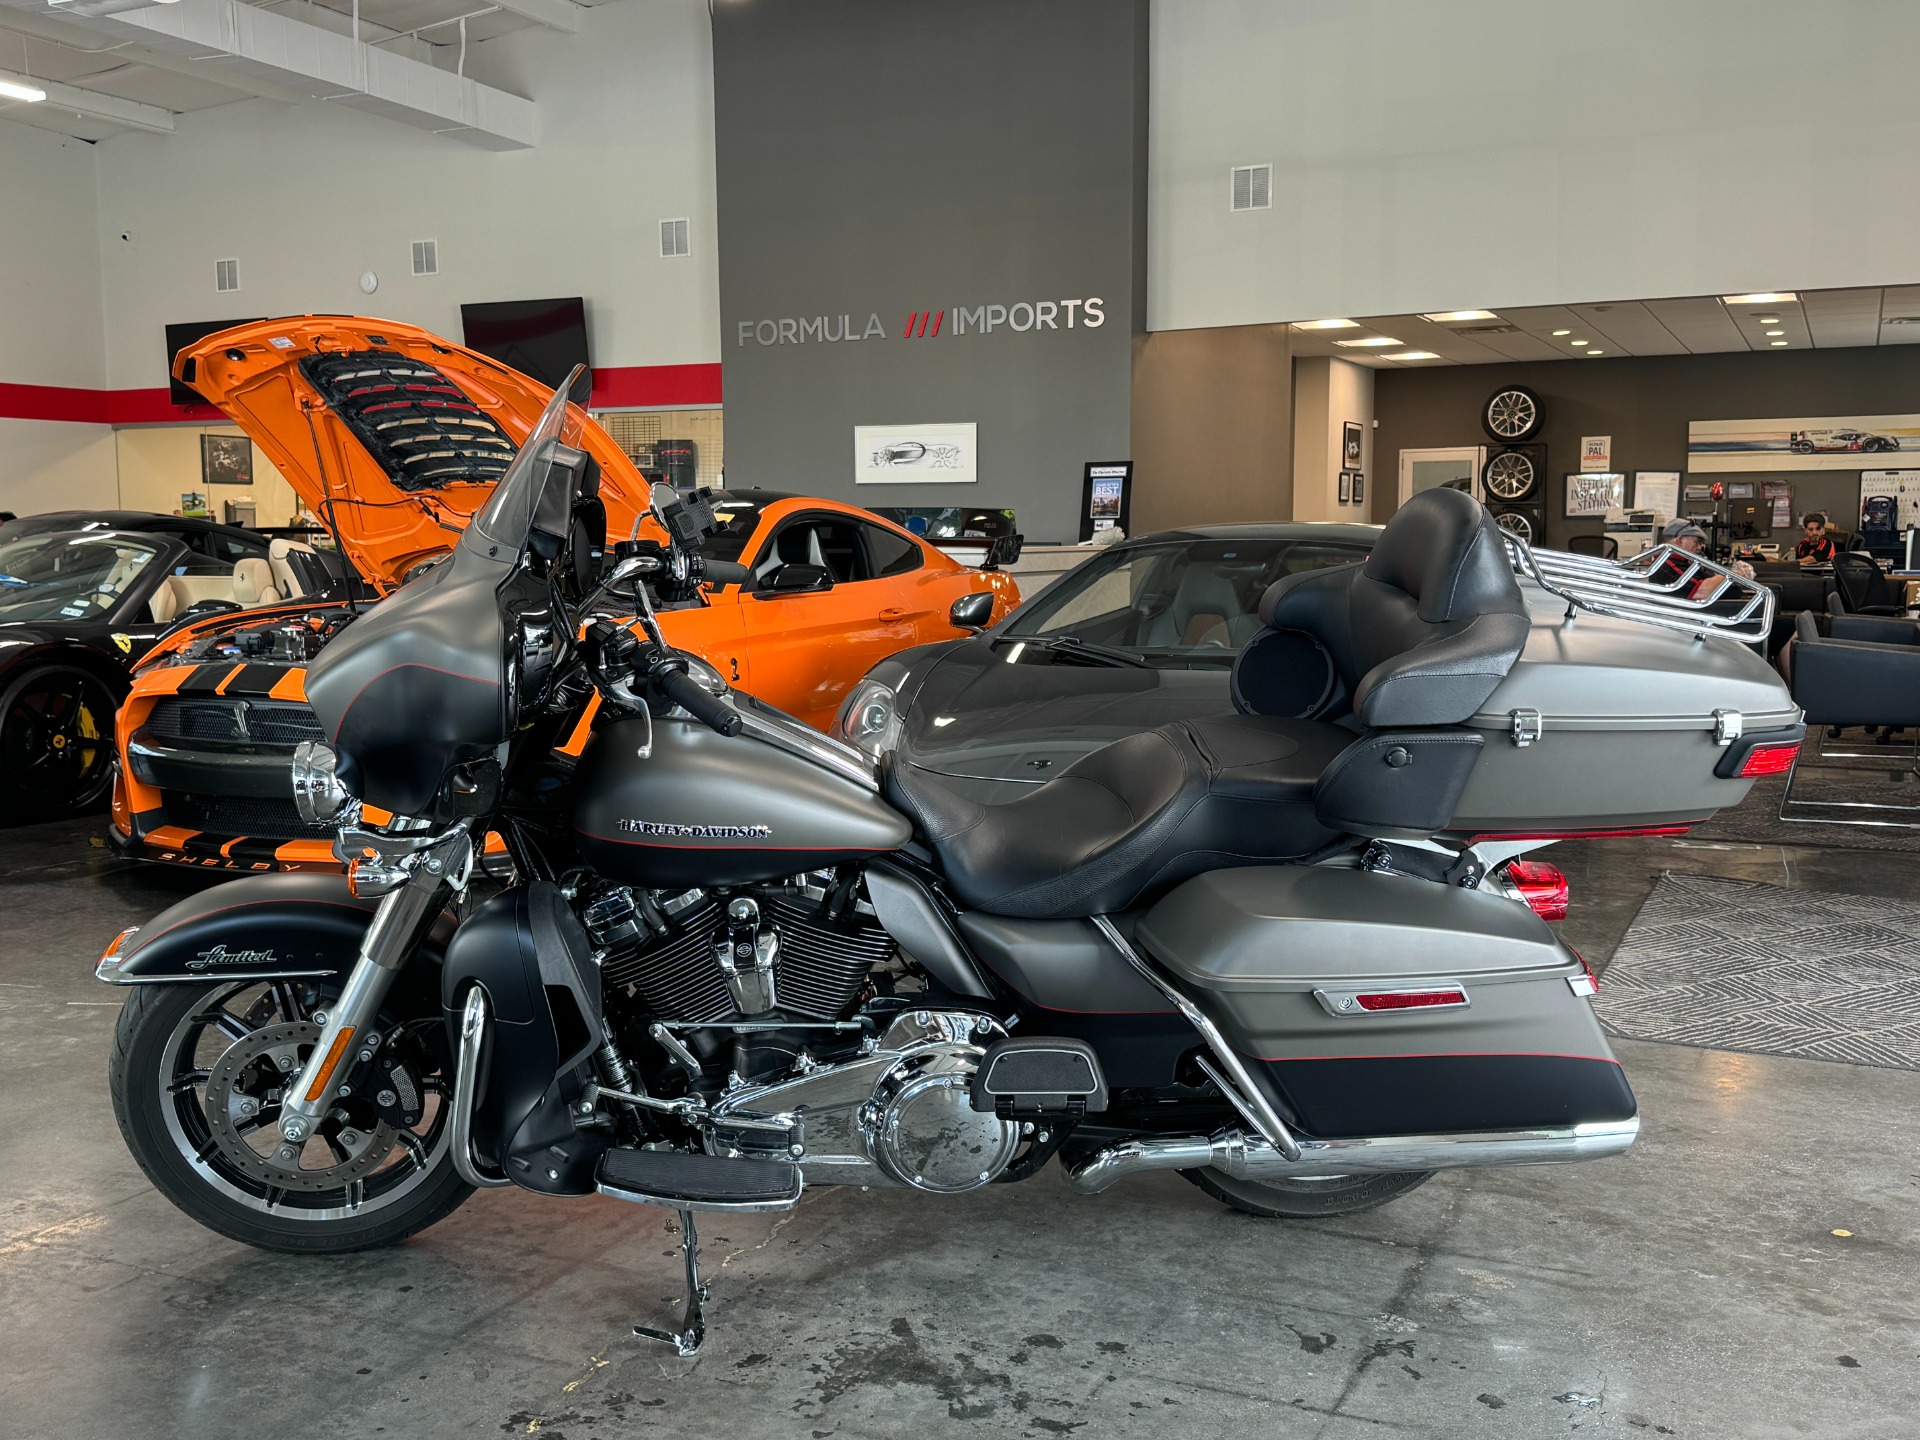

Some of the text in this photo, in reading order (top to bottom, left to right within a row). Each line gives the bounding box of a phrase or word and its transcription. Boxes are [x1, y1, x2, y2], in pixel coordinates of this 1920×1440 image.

[738, 297, 1105, 347] FORMULA IMPORTS
[1588, 447, 1602, 455] PAL
[1577, 478, 1613, 490] OFFICIAL
[1095, 486, 1119, 495] BEST
[1578, 500, 1611, 511] STATION
[158, 852, 301, 872] SHELBY
[185, 944, 278, 971] Limited
